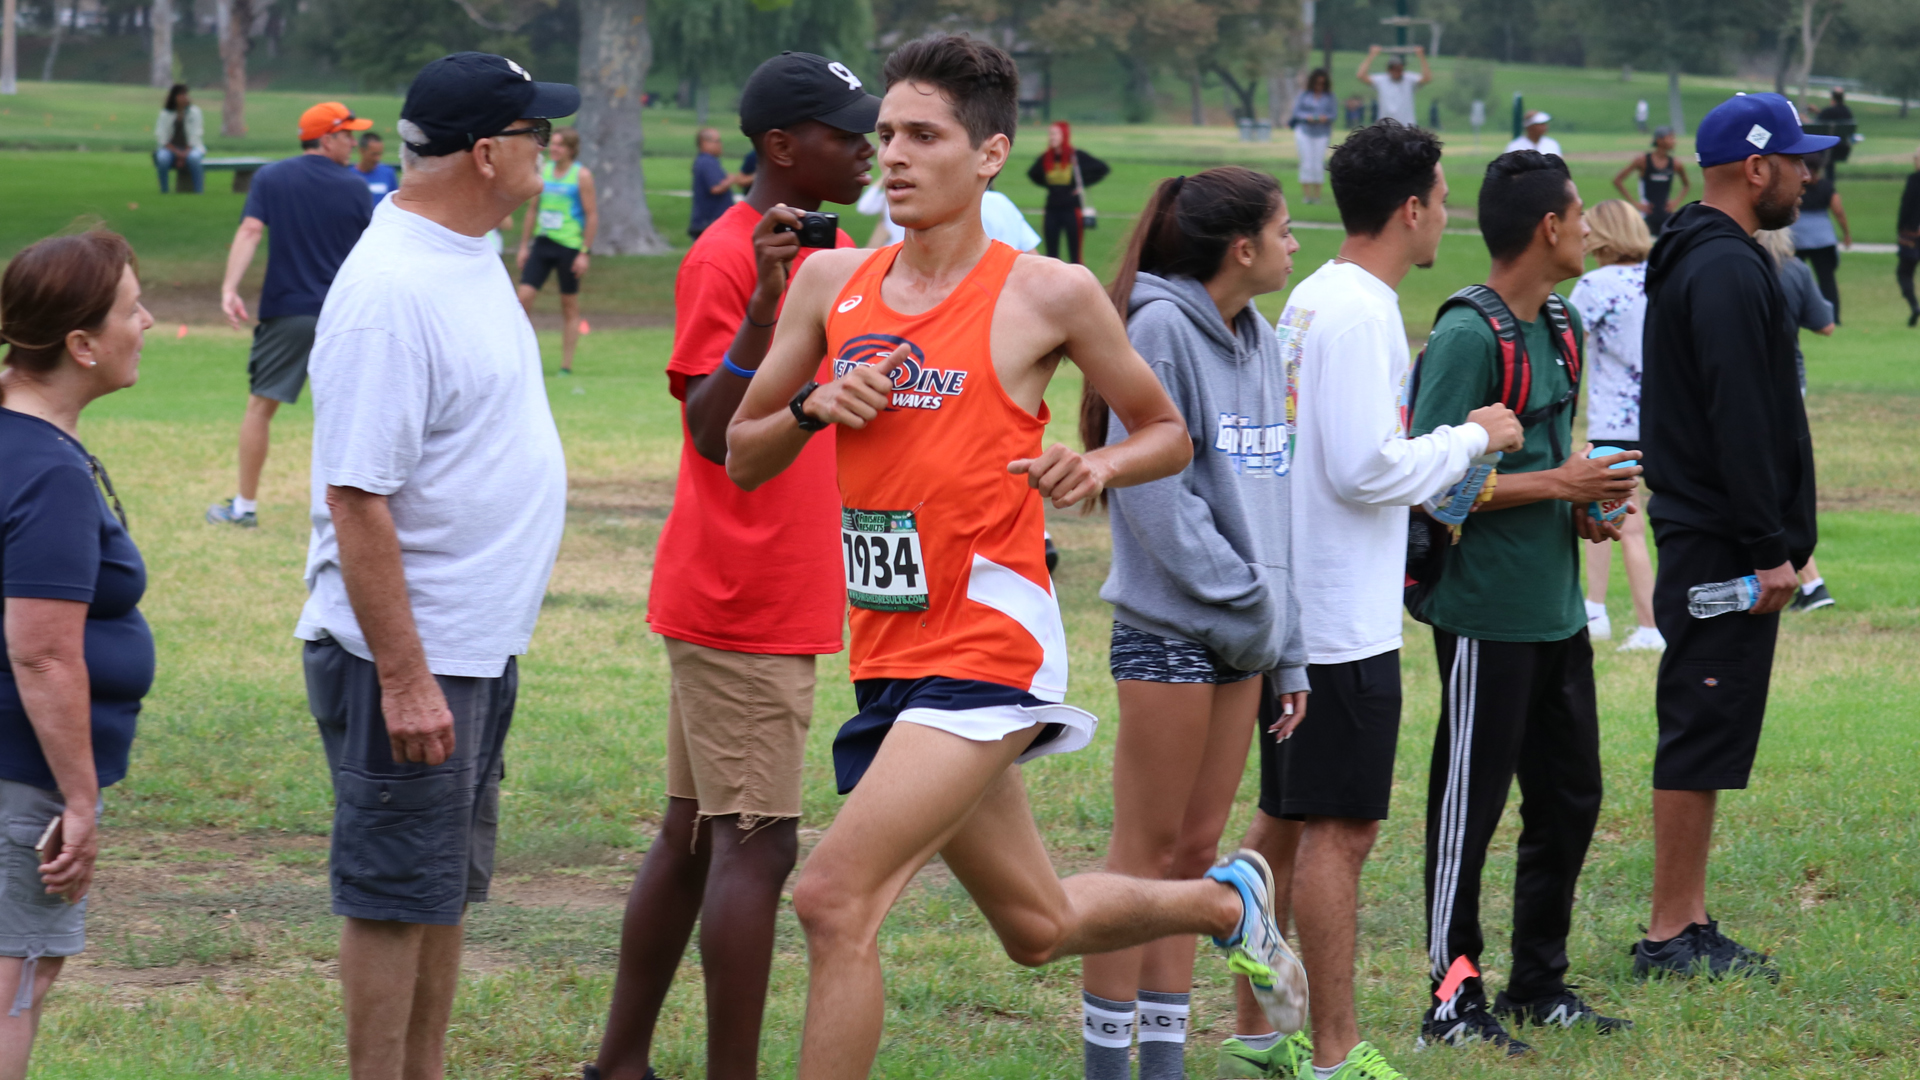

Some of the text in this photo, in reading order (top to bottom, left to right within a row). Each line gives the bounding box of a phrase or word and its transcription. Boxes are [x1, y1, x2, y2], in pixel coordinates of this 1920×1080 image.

[892, 393, 942, 409] WAVES
[859, 513, 885, 524] FINISHED
[859, 523, 884, 532] RESULTS
